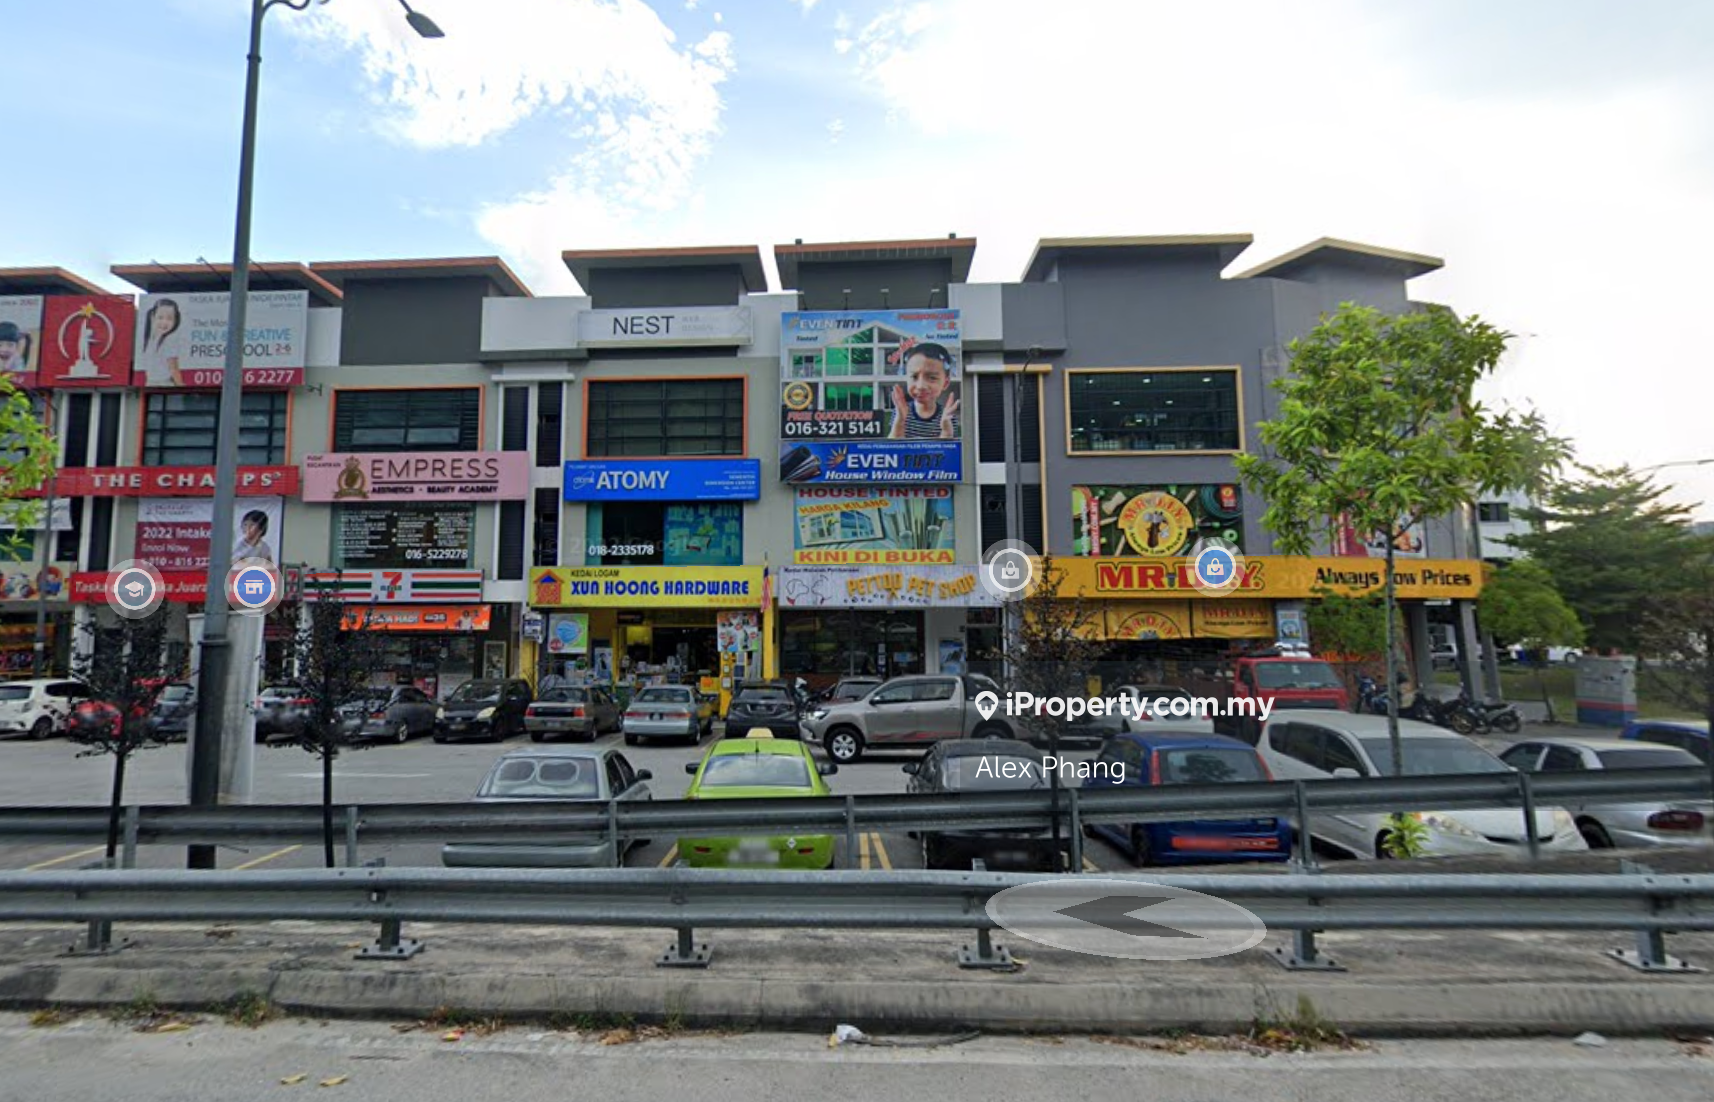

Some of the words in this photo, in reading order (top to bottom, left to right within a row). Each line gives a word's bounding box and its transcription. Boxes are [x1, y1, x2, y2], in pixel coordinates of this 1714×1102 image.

[193, 318, 208, 327] The
[612, 316, 675, 335] NEST
[191, 329, 219, 341] FUN
[257, 369, 294, 384] 2277
[785, 422, 844, 435] 016-321
[848, 422, 881, 434] 5141
[847, 454, 898, 468] EVEN
[370, 458, 499, 479] EMPRESS
[825, 470, 868, 479] House
[872, 470, 925, 479] Window
[926, 470, 958, 479] Film
[92, 474, 141, 487] THE
[158, 473, 272, 487] CHAPS
[596, 470, 670, 489] ATOMY
[458, 486, 498, 494] ACADEMY
[799, 488, 868, 498] HOUSE
[875, 487, 950, 498] TINTED
[799, 503, 841, 514] HARGA
[845, 499, 889, 510] KILANG
[143, 527, 172, 539] 2022
[405, 549, 468, 559] 016-5229278
[588, 544, 655, 556] 018-2335178
[799, 551, 848, 563] KINI
[855, 551, 880, 563] DI
[885, 550, 953, 563] BUKA
[1099, 566, 1165, 589] MR
[1315, 567, 1380, 589] Always
[1421, 569, 1473, 586] Prices
[571, 581, 600, 595] XUN
[604, 581, 660, 595] HOONG
[664, 580, 749, 595] HARDWARE
[938, 573, 977, 599] SHOP
